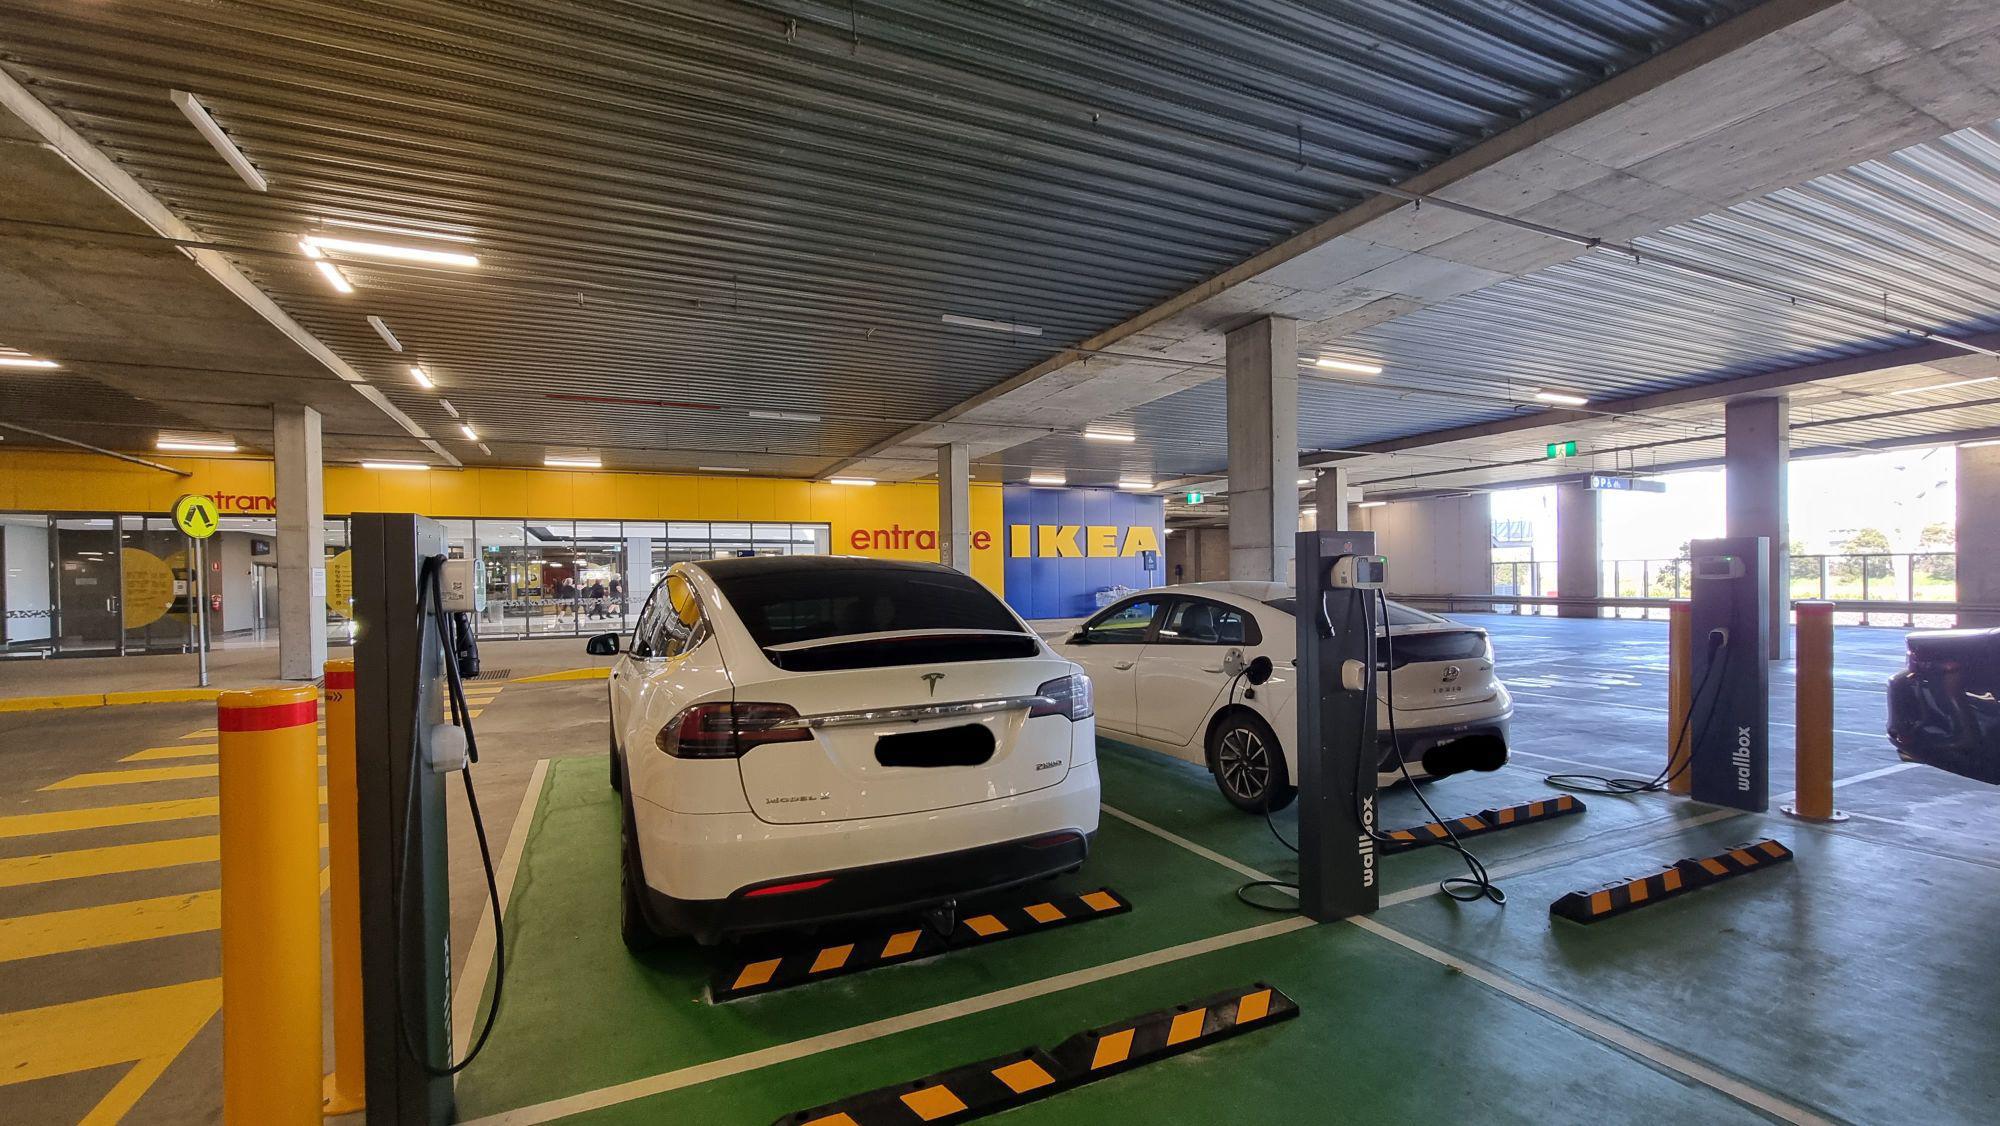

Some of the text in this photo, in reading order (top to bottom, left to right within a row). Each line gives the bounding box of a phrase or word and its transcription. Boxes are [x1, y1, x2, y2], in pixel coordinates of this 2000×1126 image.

[850, 524, 991, 550] entrae
[1010, 524, 1162, 558] IKEA
[1732, 726, 1751, 791] wallbox
[1359, 794, 1374, 887] wallbox
